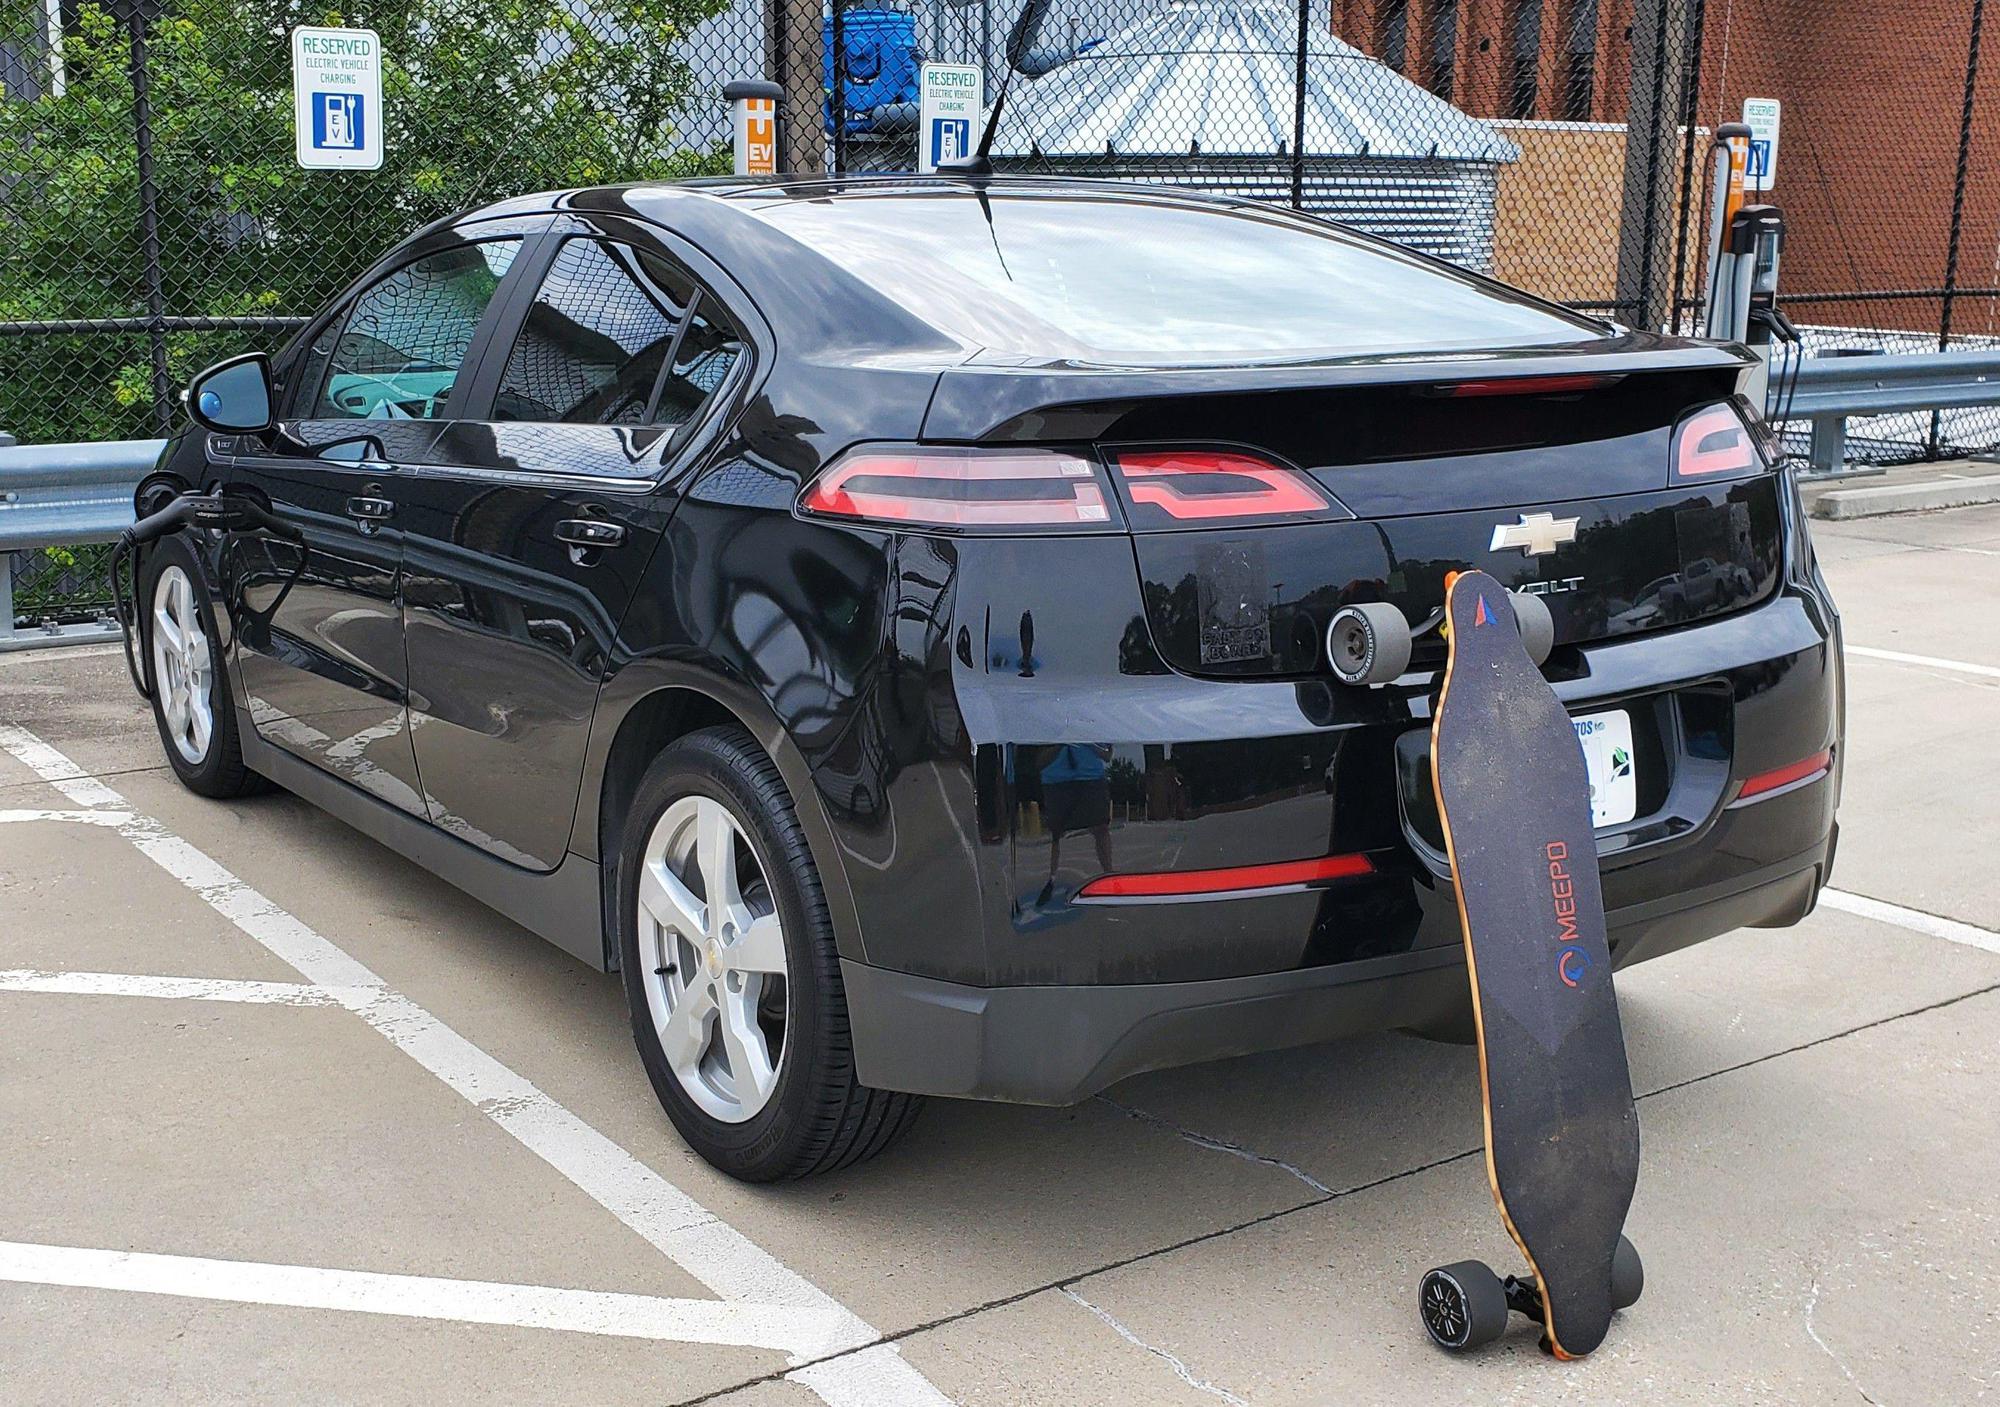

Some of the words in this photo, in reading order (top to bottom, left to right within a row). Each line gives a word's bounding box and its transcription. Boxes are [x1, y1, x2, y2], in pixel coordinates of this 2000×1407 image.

[303, 37, 371, 56] RESERVED
[305, 57, 339, 70] ELECTRIC
[340, 59, 369, 71] VEHICLE
[320, 73, 357, 85] CHARGING
[928, 71, 976, 87] RESERVED
[929, 88, 953, 99] ELECTRIC
[954, 89, 975, 100] VEHICLE
[938, 101, 965, 112] CHARGING
[749, 143, 772, 161] EV
[1546, 840, 1580, 942] MEEPO
